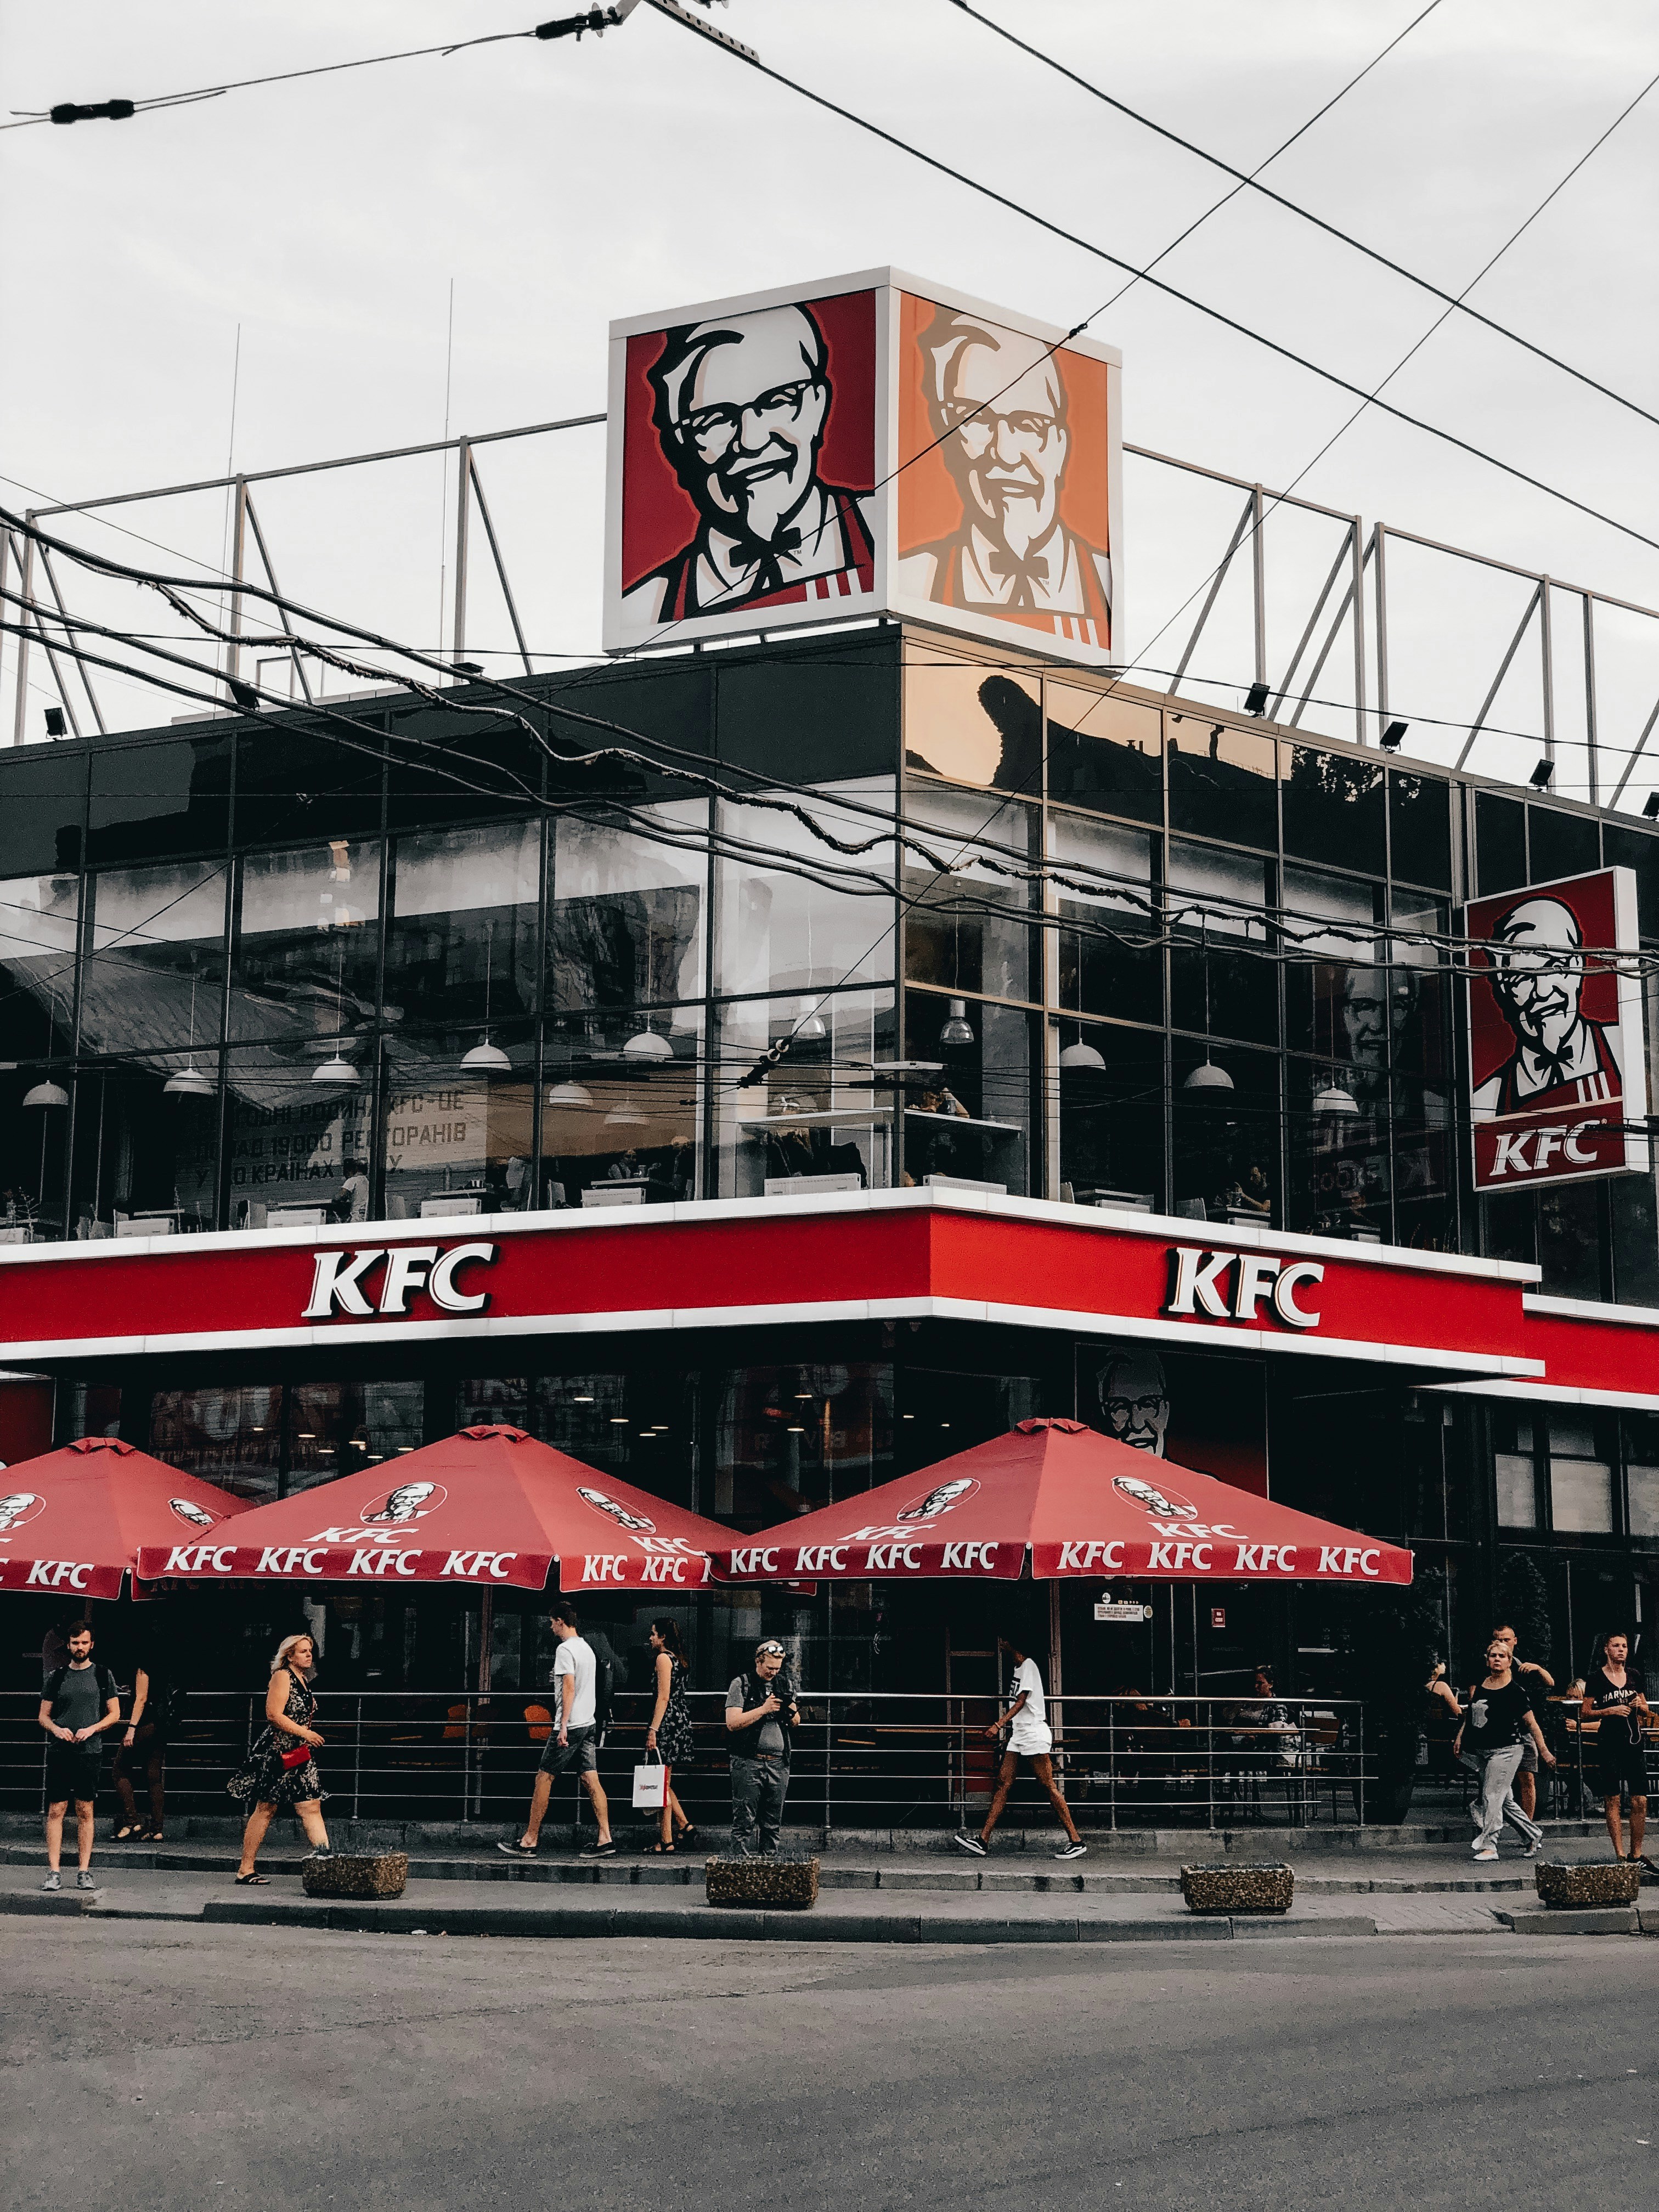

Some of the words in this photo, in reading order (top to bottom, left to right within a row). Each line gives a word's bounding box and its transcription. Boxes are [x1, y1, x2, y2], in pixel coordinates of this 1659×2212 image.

[270, 1133, 332, 1156] 19000
[342, 1122, 466, 1152] РЕОРАНІВ
[1489, 1120, 1600, 1176] KFC
[251, 1156, 334, 1184] КРАЇНАХ
[301, 1243, 494, 1318] KFC
[1167, 1247, 1324, 1327] KFC
[303, 1527, 419, 1544] KFC
[837, 1524, 937, 1541] KFC
[1148, 1522, 1249, 1539] KFC
[628, 1536, 704, 1556] KFC
[730, 1547, 781, 1573] KFC
[794, 1545, 850, 1571] KFC
[865, 1543, 924, 1569] KFC
[940, 1542, 1000, 1570] KFC
[1057, 1541, 1125, 1570] KFC
[1147, 1542, 1213, 1570] KFC
[1234, 1544, 1297, 1572] KFC
[1318, 1546, 1380, 1576] KFC
[26, 1560, 95, 1588] KFC
[163, 1545, 238, 1572] KFC
[255, 1547, 329, 1574] KFC
[346, 1549, 423, 1575] KFC
[439, 1550, 518, 1578] KFC
[581, 1554, 628, 1582] KFC
[640, 1556, 688, 1582] KFC
[1602, 1689, 1637, 1703] HARVA
